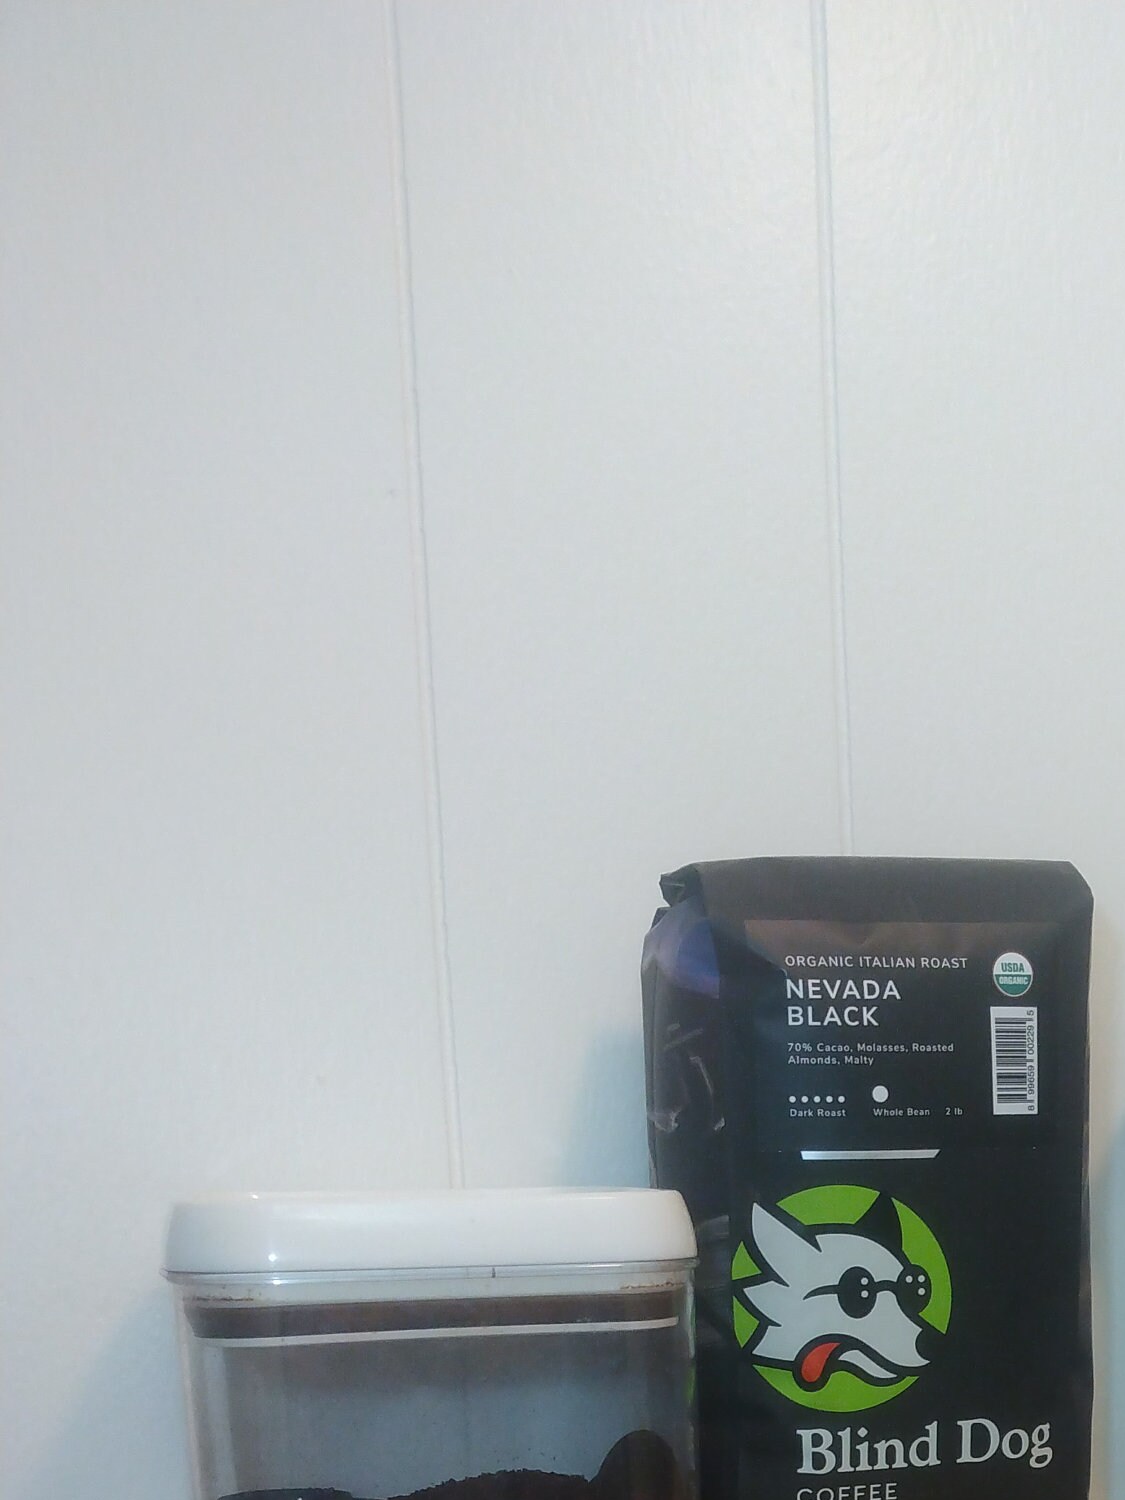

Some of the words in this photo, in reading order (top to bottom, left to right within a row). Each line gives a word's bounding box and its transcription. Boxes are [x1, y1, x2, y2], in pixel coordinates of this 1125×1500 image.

[785, 955, 854, 967] ORGANIC
[859, 956, 916, 968] ITALIAN
[920, 957, 968, 969] ROAST
[1001, 962, 1025, 973] USDA
[999, 976, 1029, 985] ORGANIC
[786, 979, 901, 1000] NEVADA
[786, 1005, 880, 1027] BLACK
[787, 1042, 813, 1052] 70%
[816, 1042, 853, 1053] Cacao,
[857, 1042, 909, 1053] Molasses,
[912, 1043, 954, 1052] Roasted
[787, 1055, 841, 1065] Almonds,
[844, 1056, 874, 1066] Malty
[789, 1108, 814, 1117] Dark
[817, 1108, 847, 1117] Roast
[873, 1107, 904, 1117] Whole
[907, 1107, 931, 1116] Bean
[945, 1107, 952, 1116] 2
[954, 1107, 964, 1116] lb
[797, 1421, 941, 1475] Blind
[956, 1418, 1054, 1468] Dog
